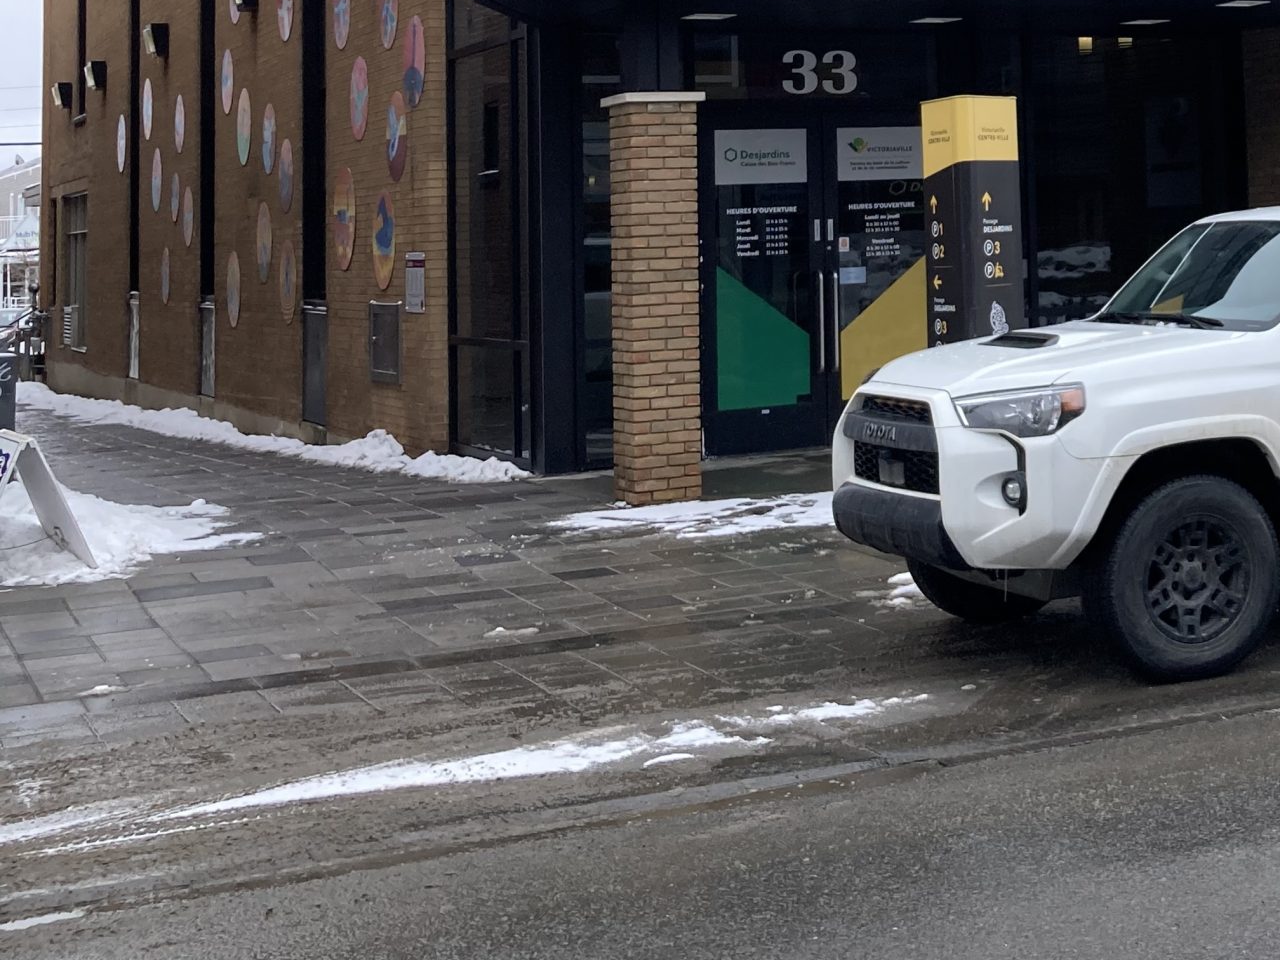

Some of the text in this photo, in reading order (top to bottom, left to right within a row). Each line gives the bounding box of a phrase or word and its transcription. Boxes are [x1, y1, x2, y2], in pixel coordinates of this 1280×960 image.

[782, 50, 857, 94] 33
[740, 150, 790, 160] Desjardins
[726, 206, 797, 215] HEURES D'OUVERTURE
[874, 201, 915, 209] D'OUVERTURE
[939, 223, 944, 236] 1
[983, 225, 1013, 234] DESJARDINS
[939, 244, 945, 258] 2
[994, 240, 1001, 255] 3
[942, 321, 948, 335] 3
[863, 422, 896, 441] TOYOTA
